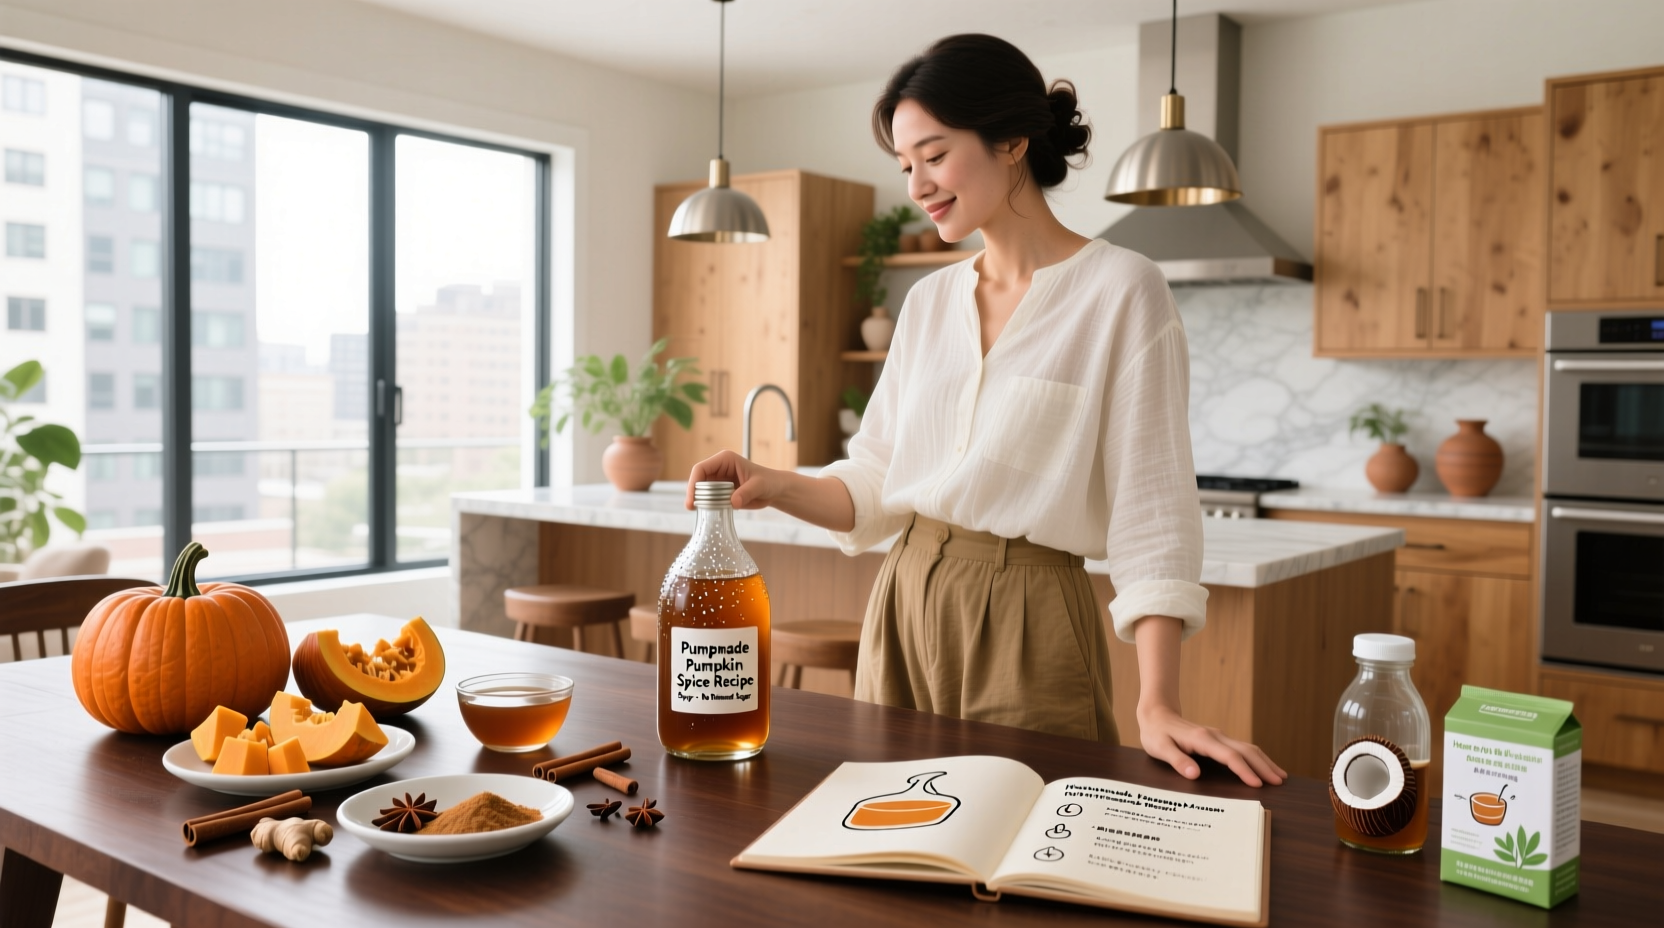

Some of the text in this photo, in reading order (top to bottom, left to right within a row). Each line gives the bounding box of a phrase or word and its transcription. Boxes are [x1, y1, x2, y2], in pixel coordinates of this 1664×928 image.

[682, 640, 749, 659] Pumpmade
[686, 657, 743, 674] Pumpkin
[677, 673, 754, 691] Spice Recipe
